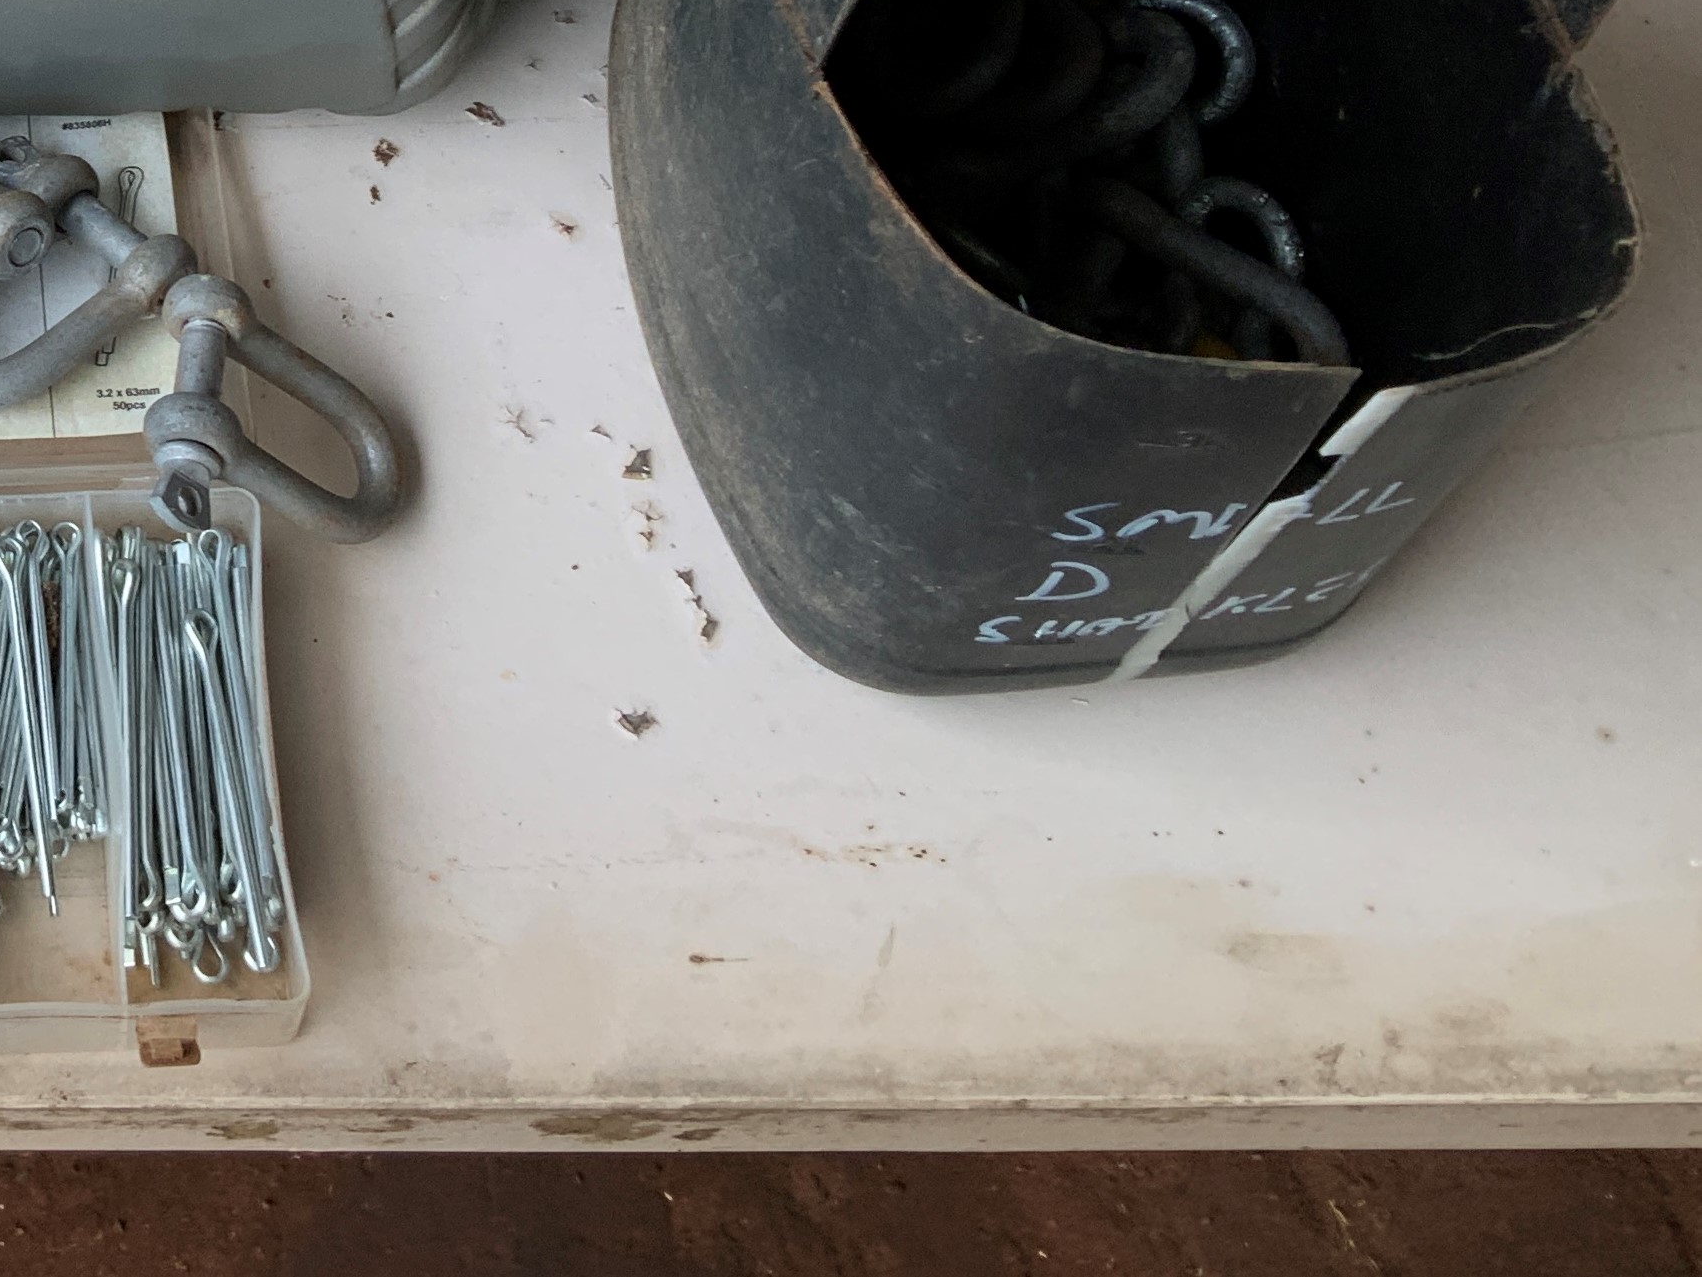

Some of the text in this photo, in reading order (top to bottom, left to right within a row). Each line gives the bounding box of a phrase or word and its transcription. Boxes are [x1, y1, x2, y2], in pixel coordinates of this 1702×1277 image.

[96, 389, 113, 398] 3.2
[125, 387, 160, 396] 63mm
[113, 401, 146, 412] 50pcs
[1015, 561, 1111, 602] D
